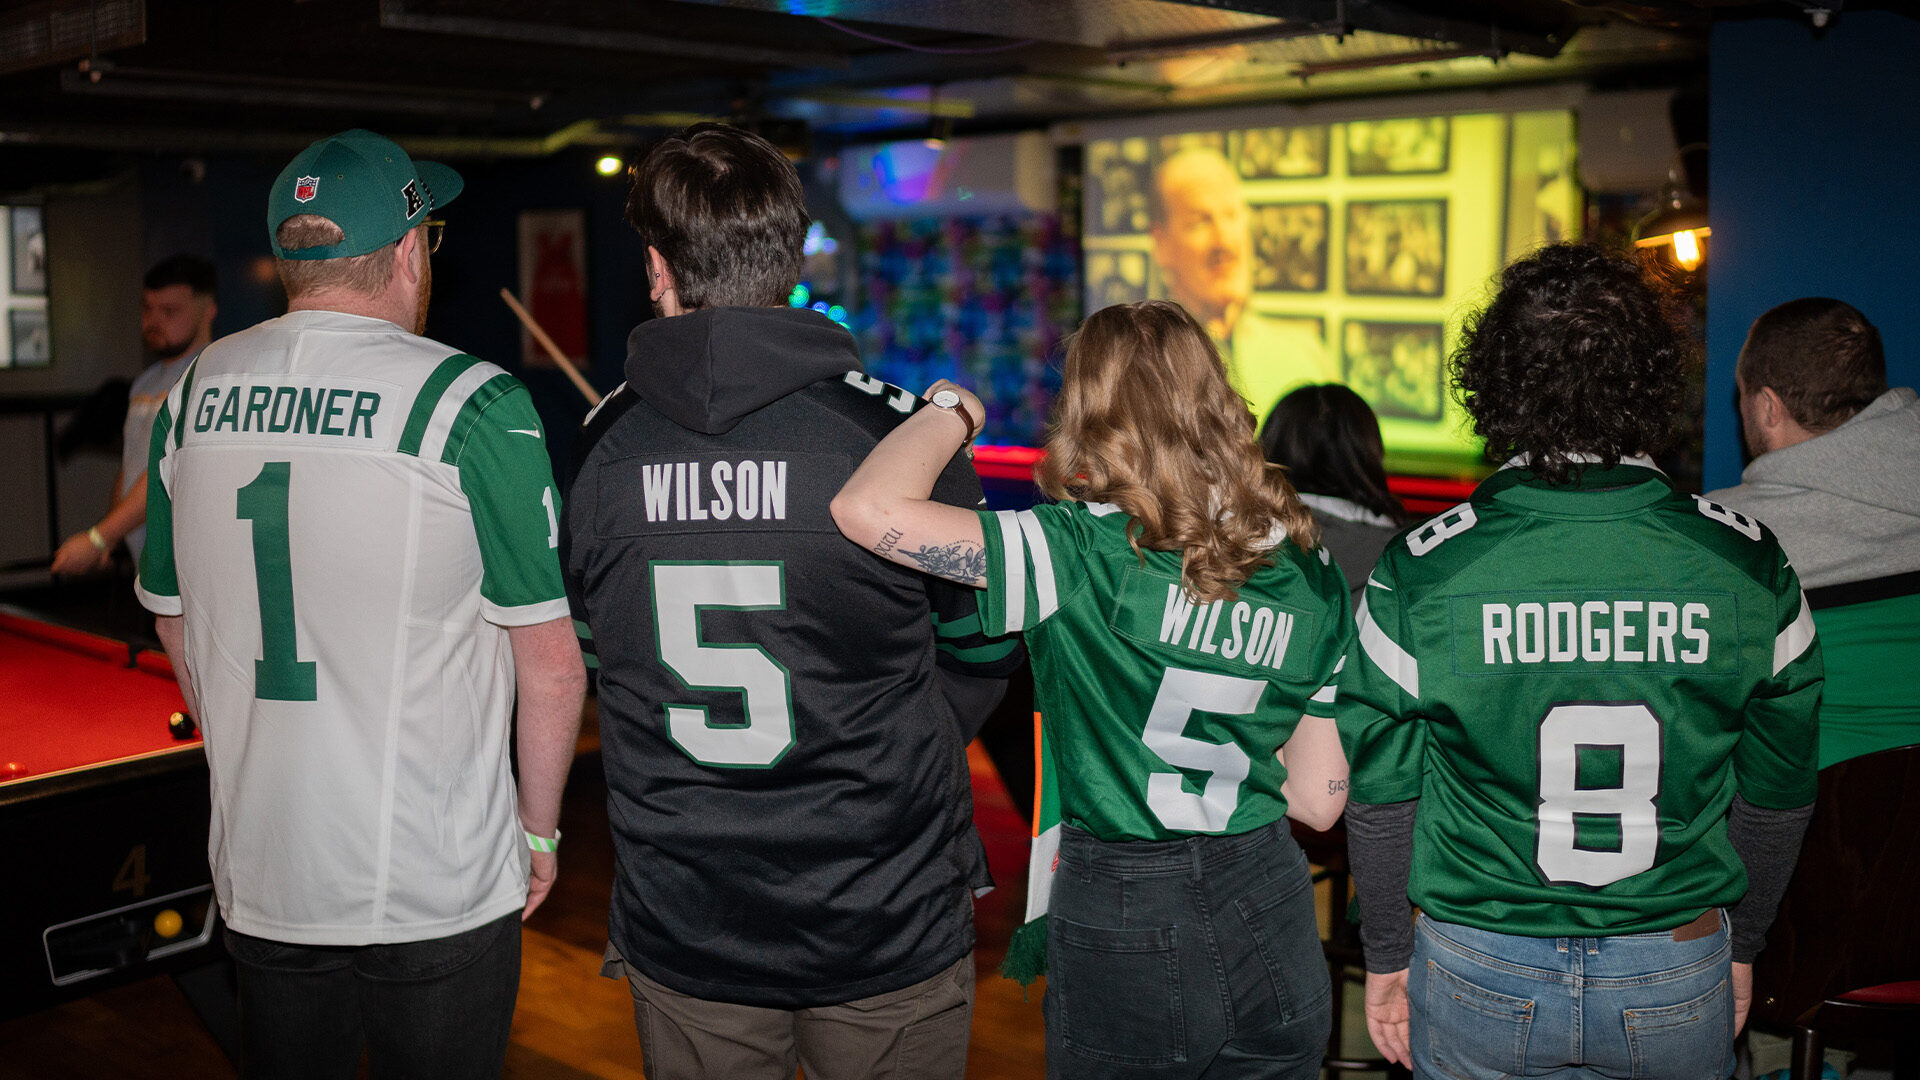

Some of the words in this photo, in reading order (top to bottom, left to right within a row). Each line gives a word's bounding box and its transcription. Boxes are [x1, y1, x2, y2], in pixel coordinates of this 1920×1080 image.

[194, 386, 381, 438] GARDNER
[541, 485, 559, 549] 1
[642, 460, 787, 522] WILSON
[1405, 501, 1478, 557] 8
[236, 461, 317, 702] 1
[1159, 583, 1294, 670] WILSON
[1482, 600, 1711, 665] RODGERS
[649, 560, 796, 769] 5
[1141, 667, 1268, 831] 5
[1533, 700, 1665, 888] 8
[112, 843, 151, 897] 4
